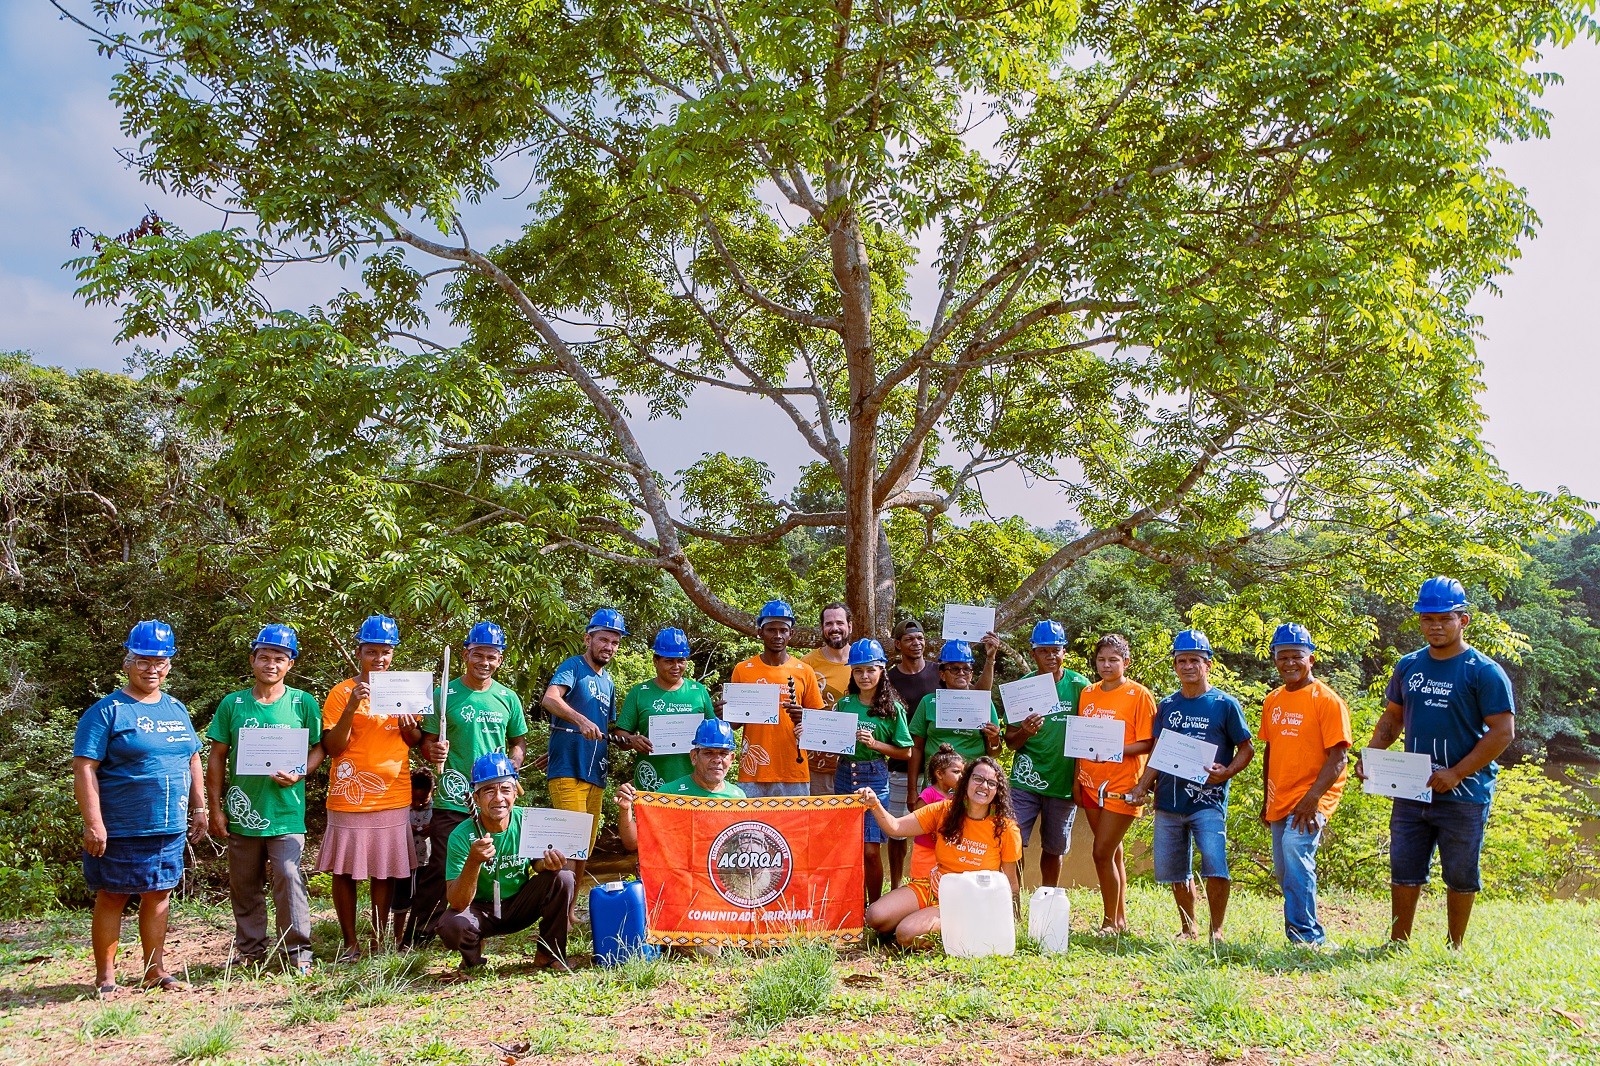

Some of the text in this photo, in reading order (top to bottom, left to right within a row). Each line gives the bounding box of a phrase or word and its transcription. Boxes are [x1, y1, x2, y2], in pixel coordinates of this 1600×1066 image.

[1427, 679, 1453, 689] Florestas
[1432, 688, 1452, 696] Valor
[1288, 718, 1302, 726] Valor
[962, 838, 988, 849] Florestas
[967, 845, 986, 855] Valor
[718, 852, 782, 867] ACORQA
[688, 909, 813, 921] COMUNIDADE ARIRAMBA
